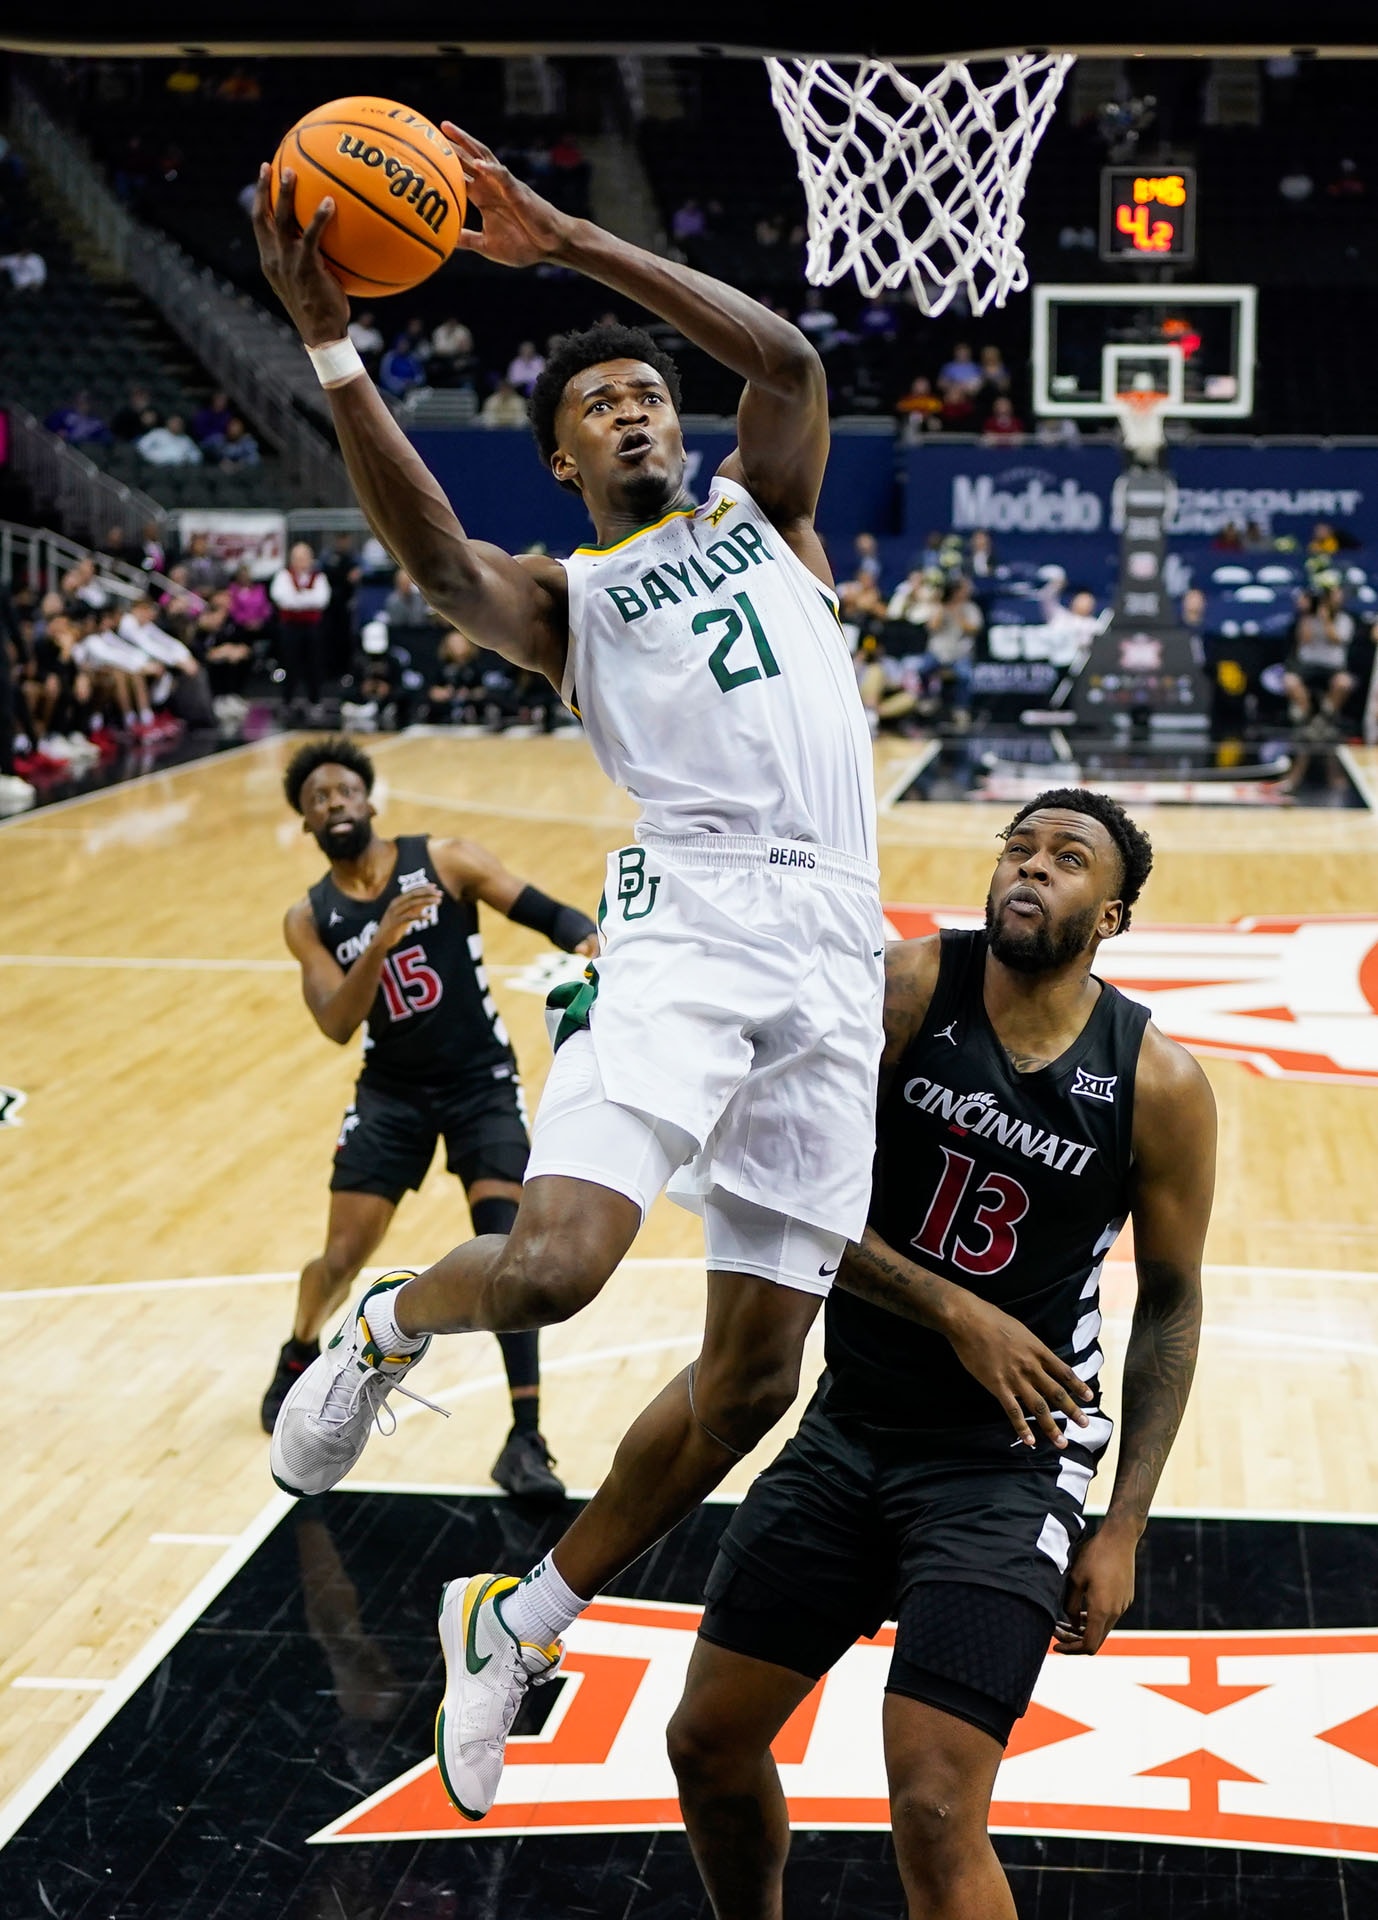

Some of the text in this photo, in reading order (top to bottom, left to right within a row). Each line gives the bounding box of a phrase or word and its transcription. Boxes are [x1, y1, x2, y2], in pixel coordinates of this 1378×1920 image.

[336, 131, 450, 235] Wilson
[952, 475, 1102, 533] Modelo
[604, 522, 776, 623] BAYLOR
[691, 591, 782, 694] 21
[769, 847, 816, 869] BEARS
[380, 944, 443, 1022] 15
[903, 1077, 1097, 1176] CINCINNATI
[909, 1144, 1030, 1276] 13
